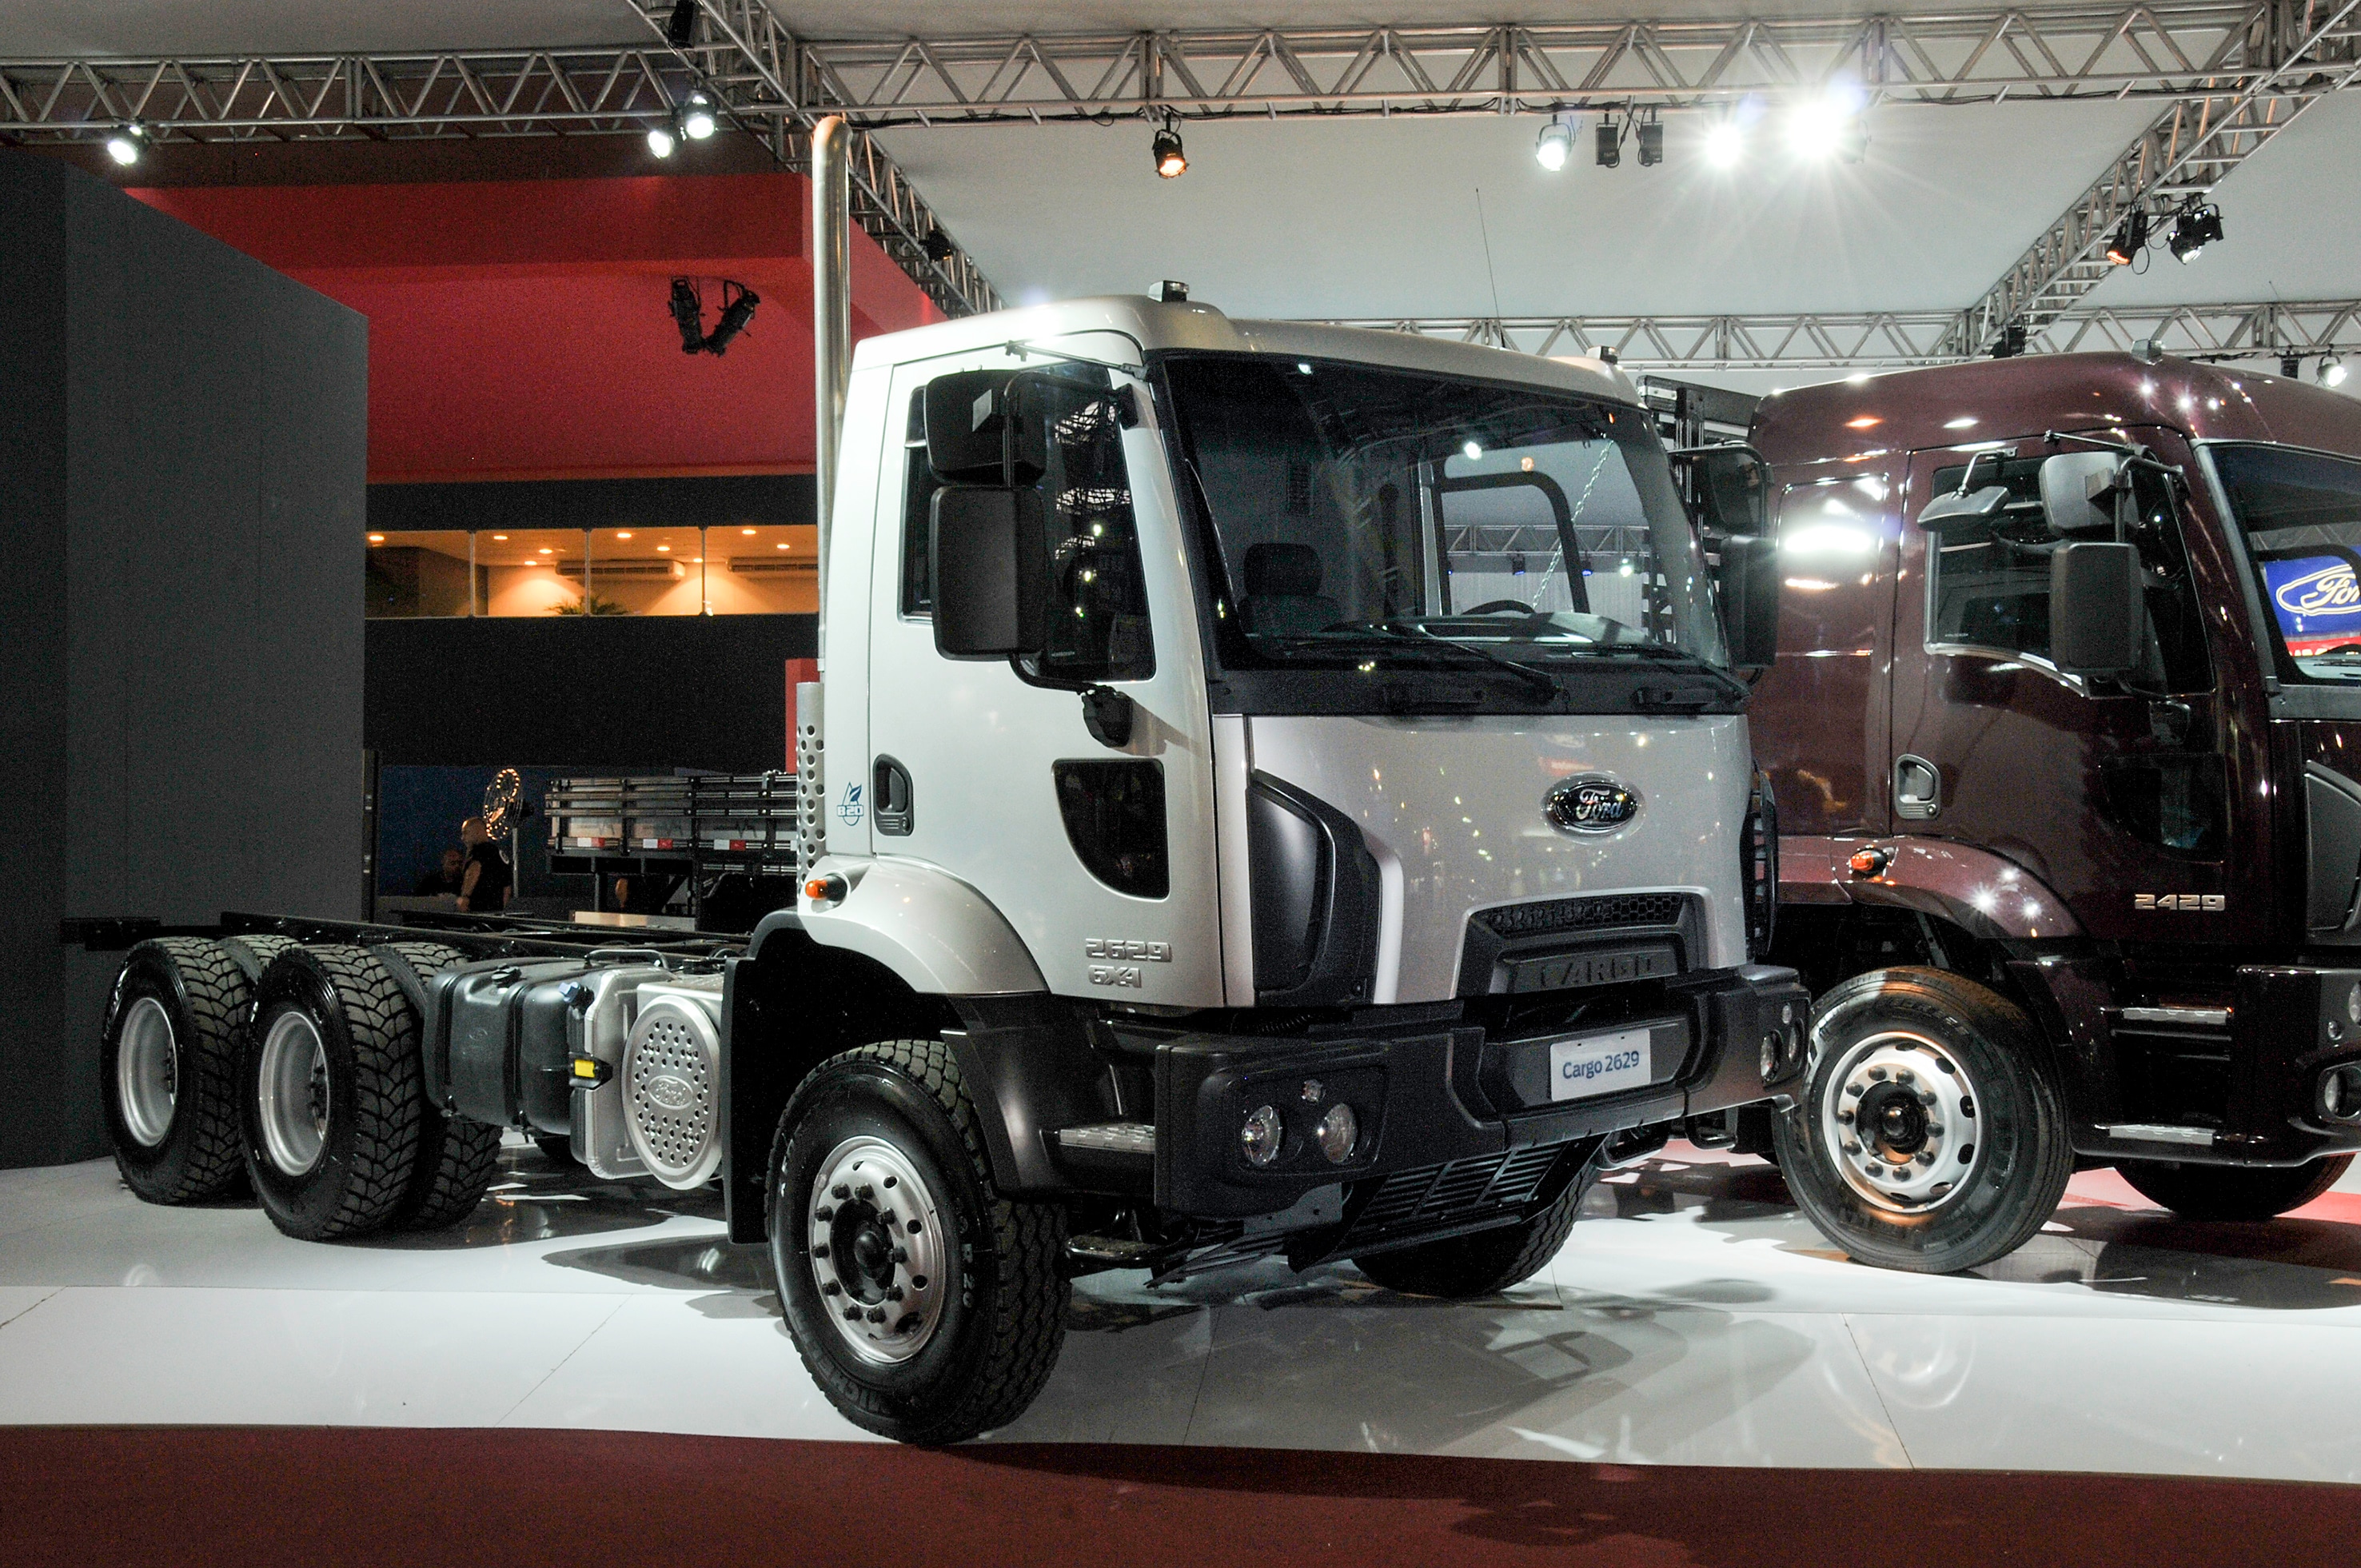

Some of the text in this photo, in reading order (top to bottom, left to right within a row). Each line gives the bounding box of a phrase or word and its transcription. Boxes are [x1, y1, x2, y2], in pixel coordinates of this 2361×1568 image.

[2300, 573, 2360, 608] For
[1575, 788, 1624, 820] Ford
[2135, 894, 2225, 911] 2429
[1086, 938, 1172, 963] 2629
[1562, 1051, 1639, 1079] Cargo 2629
